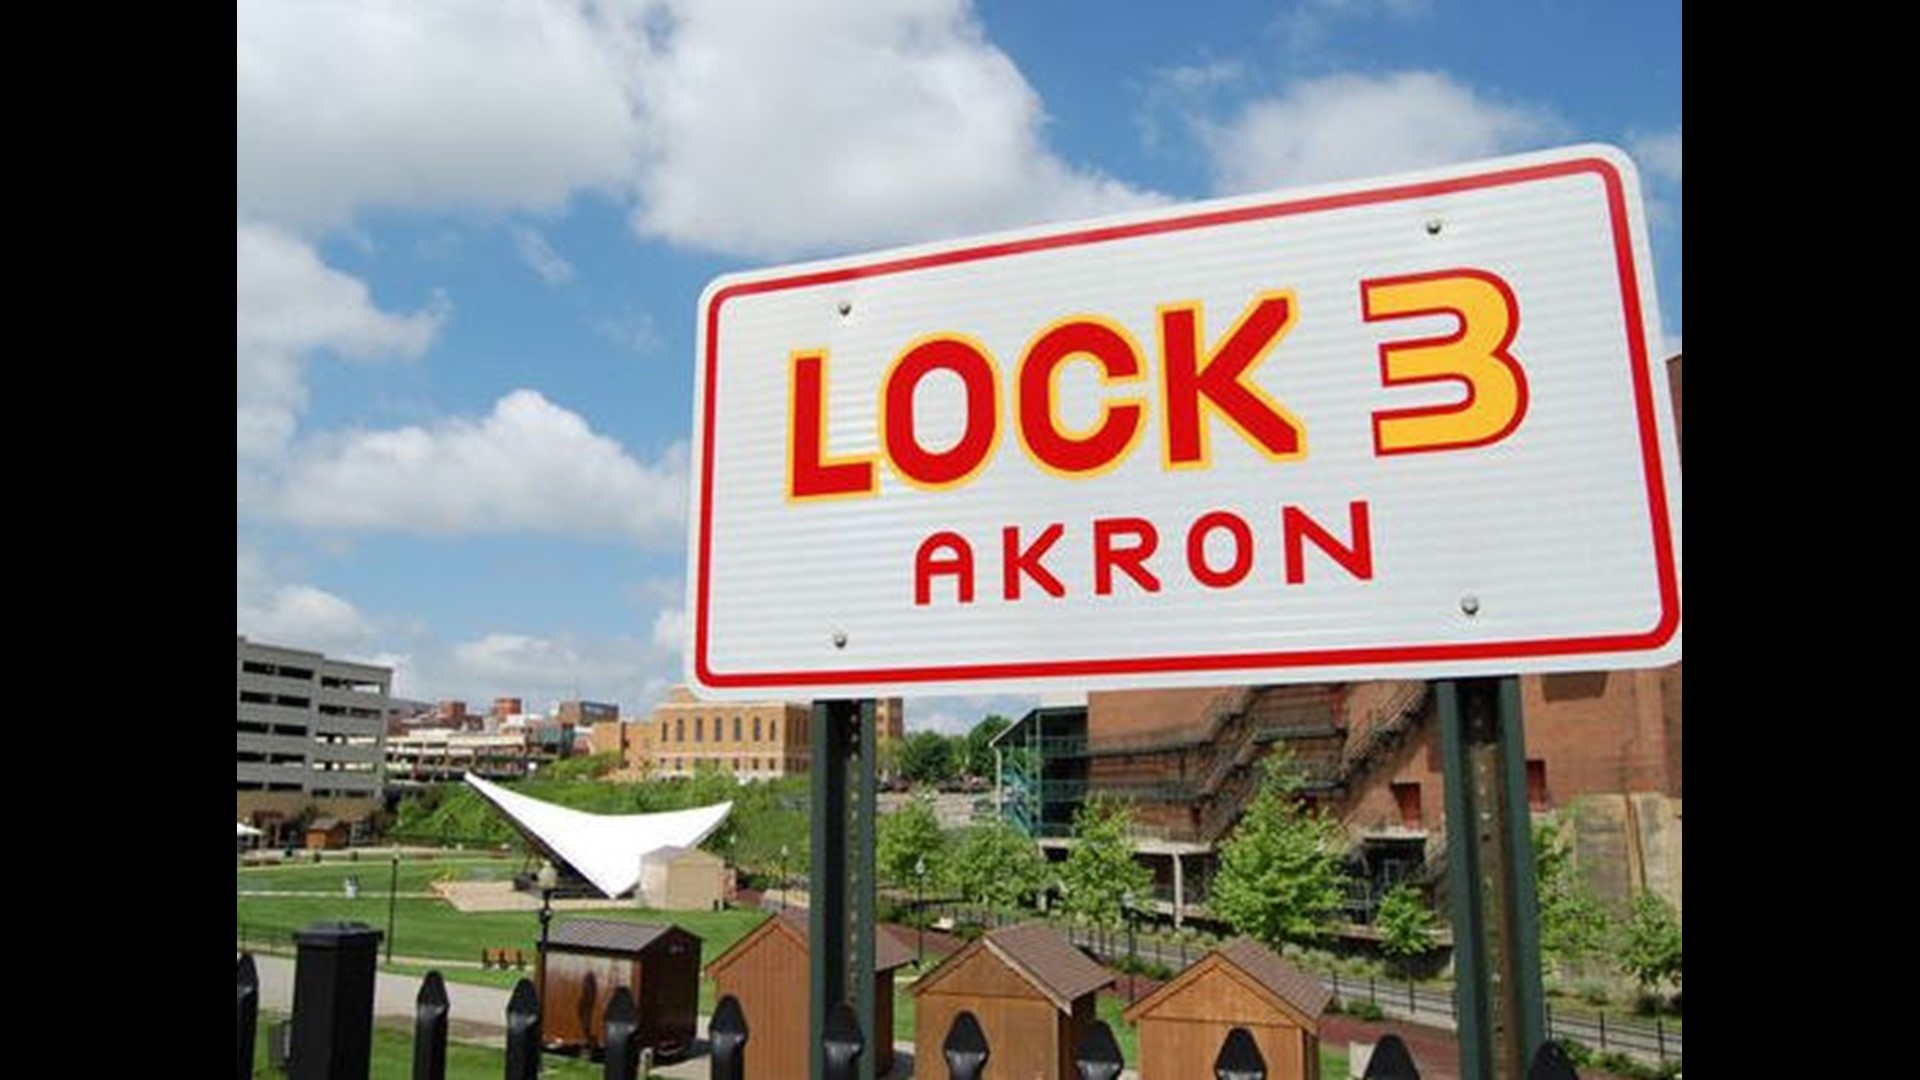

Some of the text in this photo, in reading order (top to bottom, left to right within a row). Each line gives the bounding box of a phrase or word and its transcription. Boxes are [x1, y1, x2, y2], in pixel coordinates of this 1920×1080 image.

[785, 267, 1530, 503] LOCK 3
[914, 500, 1374, 606] AKRON
